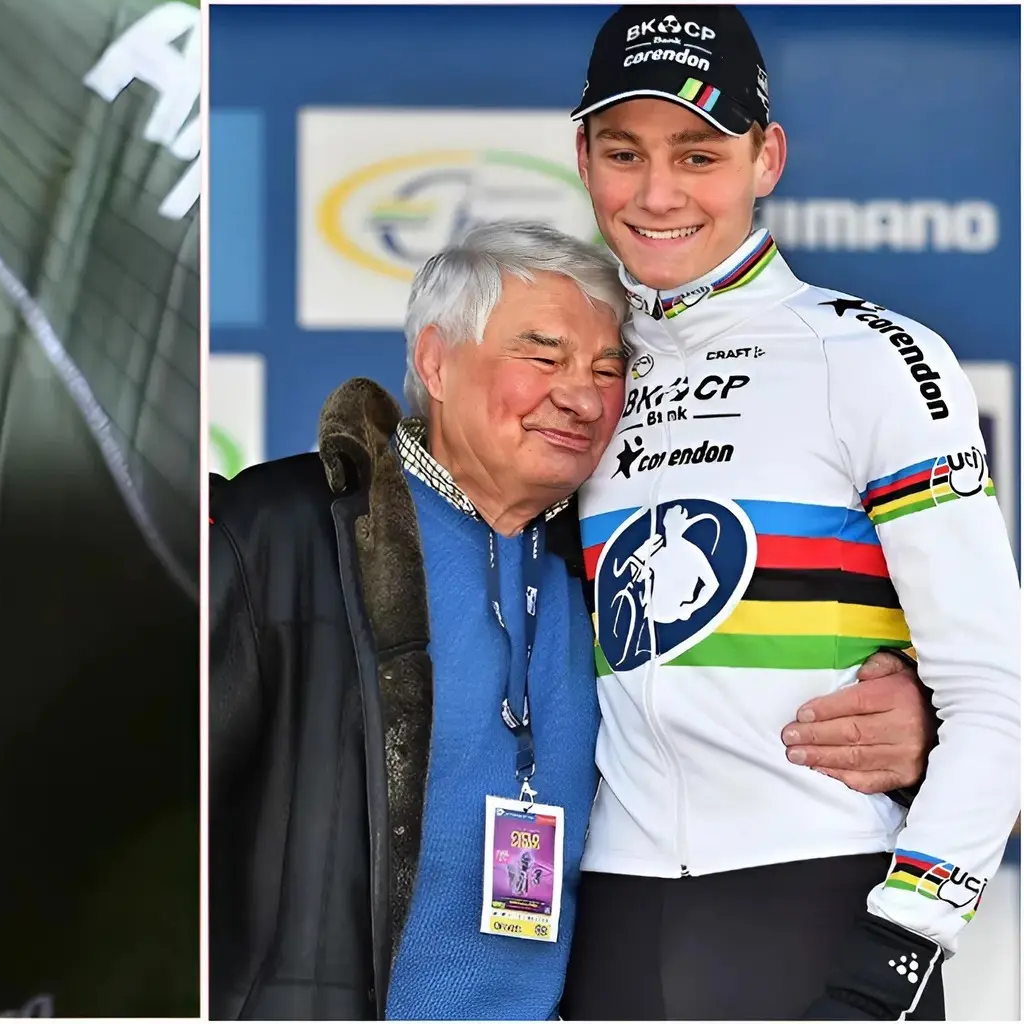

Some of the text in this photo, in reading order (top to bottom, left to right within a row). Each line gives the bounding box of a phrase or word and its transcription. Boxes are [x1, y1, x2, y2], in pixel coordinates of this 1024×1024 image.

[623, 48, 710, 72] corendon
[706, 347, 752, 360] CRAFT
[856, 313, 950, 420] corendon
